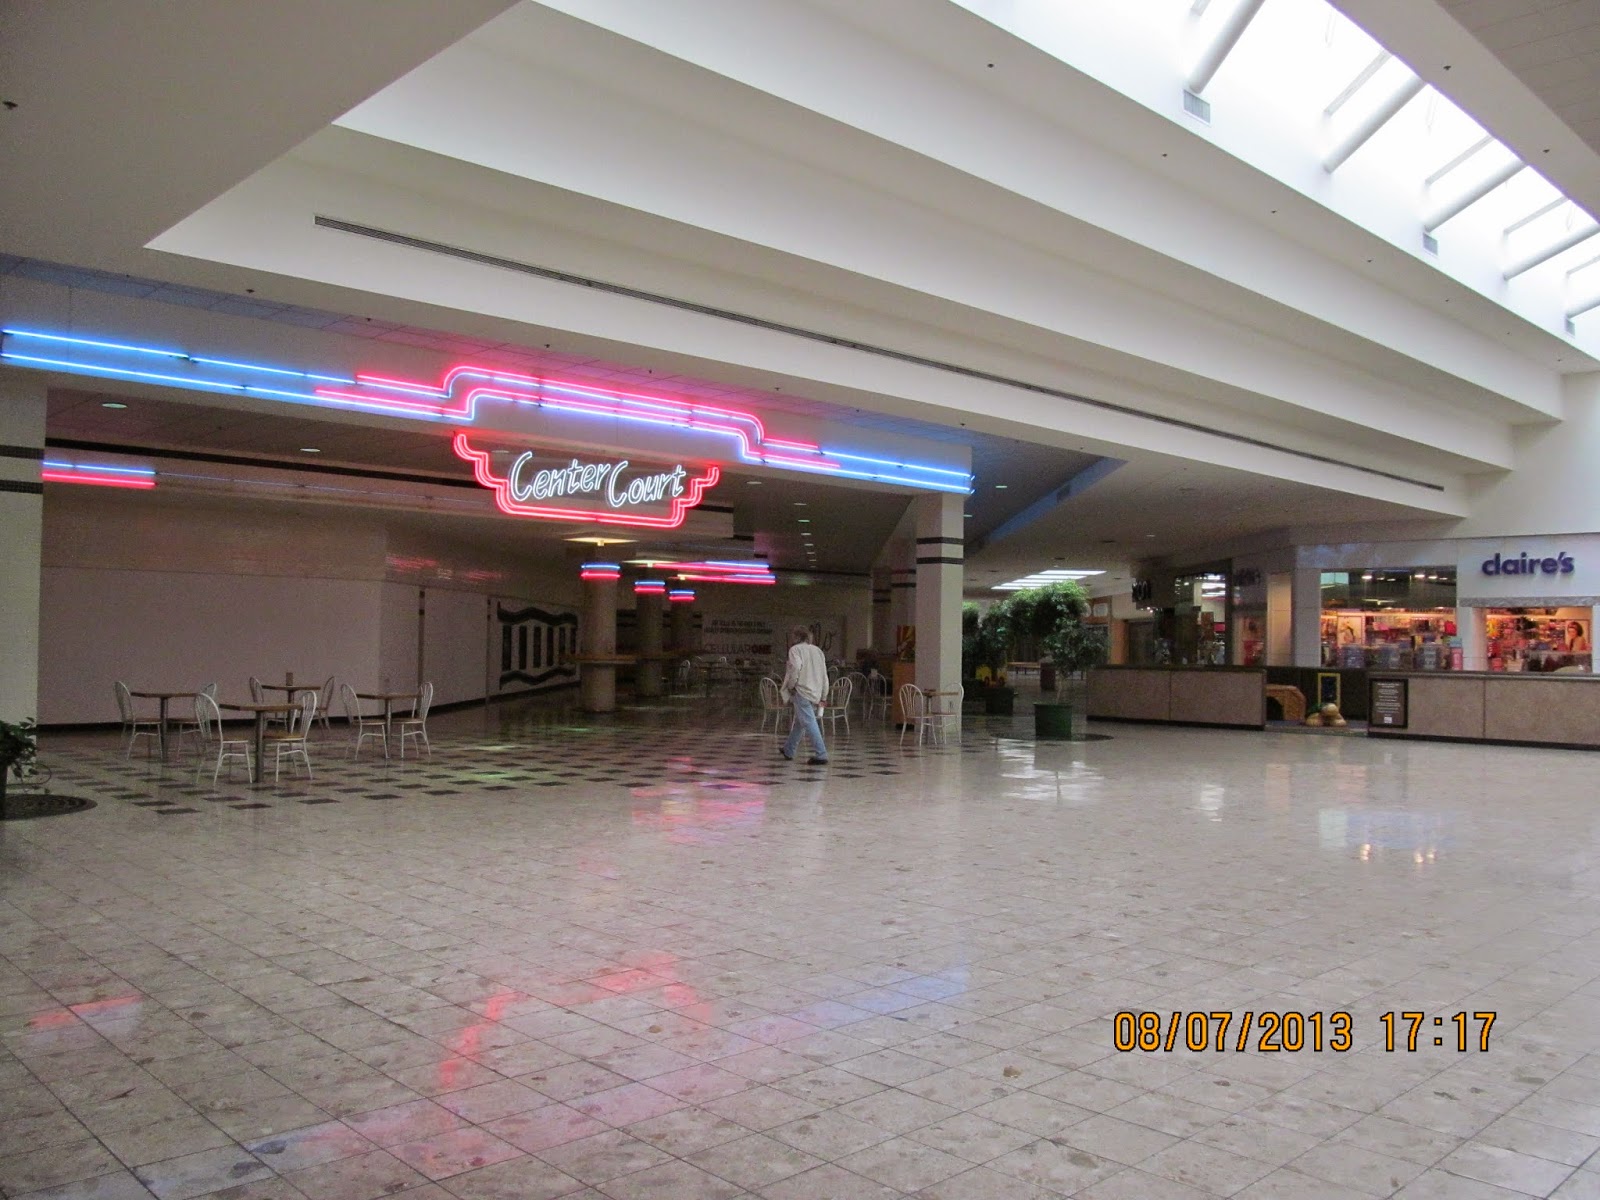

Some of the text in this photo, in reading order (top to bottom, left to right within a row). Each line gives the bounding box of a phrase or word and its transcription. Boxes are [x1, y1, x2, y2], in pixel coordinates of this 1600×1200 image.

[511, 451, 686, 507] Center Court
[1482, 552, 1575, 576] claire's
